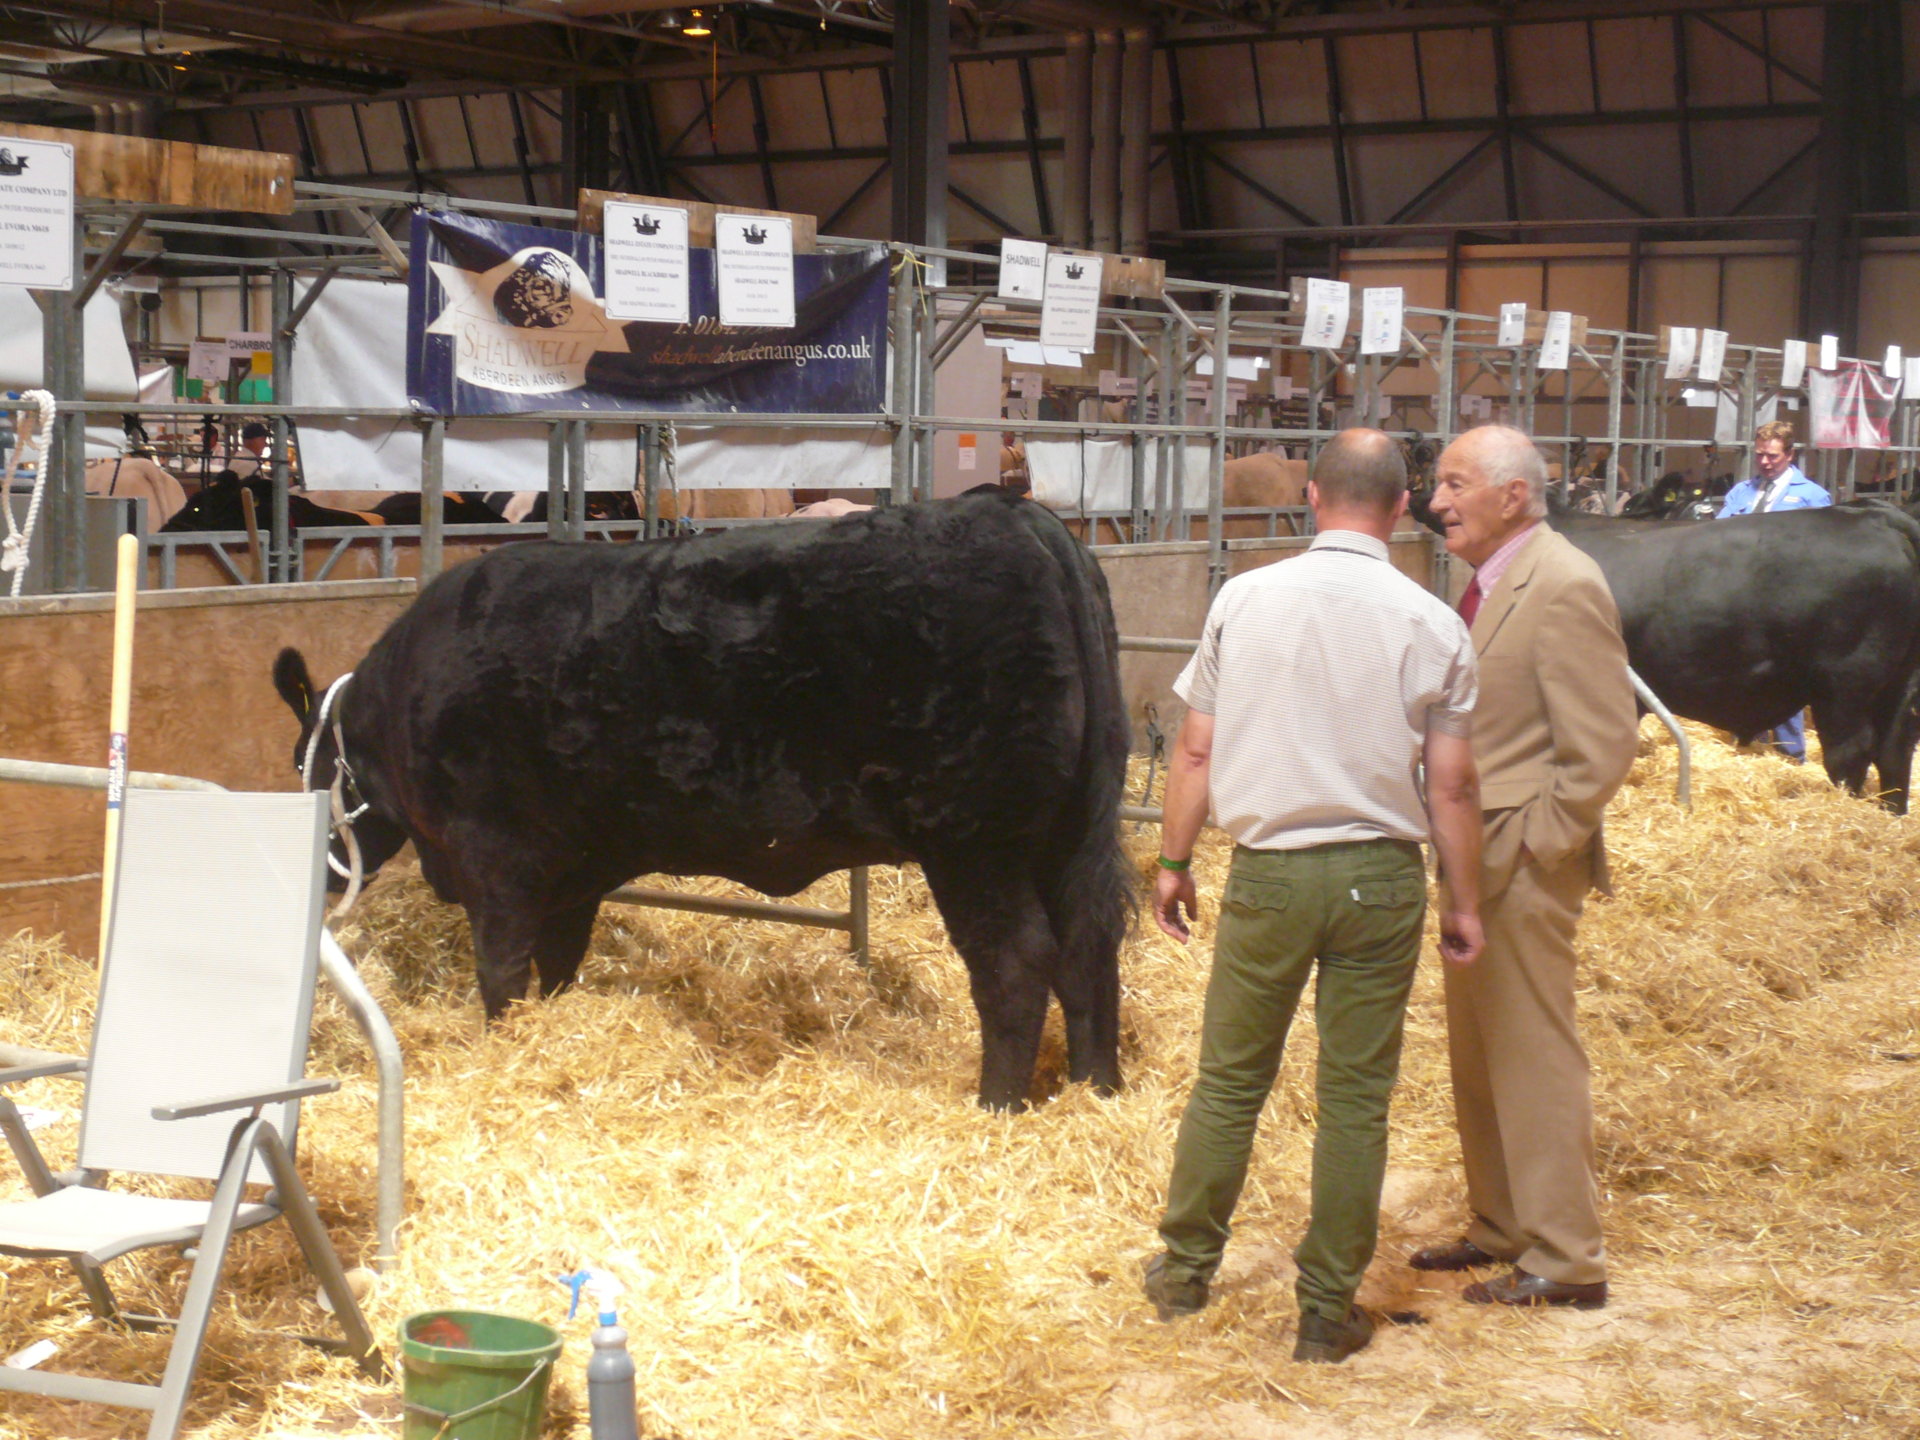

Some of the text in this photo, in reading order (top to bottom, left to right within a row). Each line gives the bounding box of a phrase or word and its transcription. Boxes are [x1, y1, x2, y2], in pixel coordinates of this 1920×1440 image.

[15, 186, 51, 195] COMPANY
[53, 189, 68, 197] LTD
[1006, 254, 1040, 267] SHADWELL
[463, 322, 582, 367] SHADWELL
[472, 365, 568, 387] ABERDEEN ANGUS
